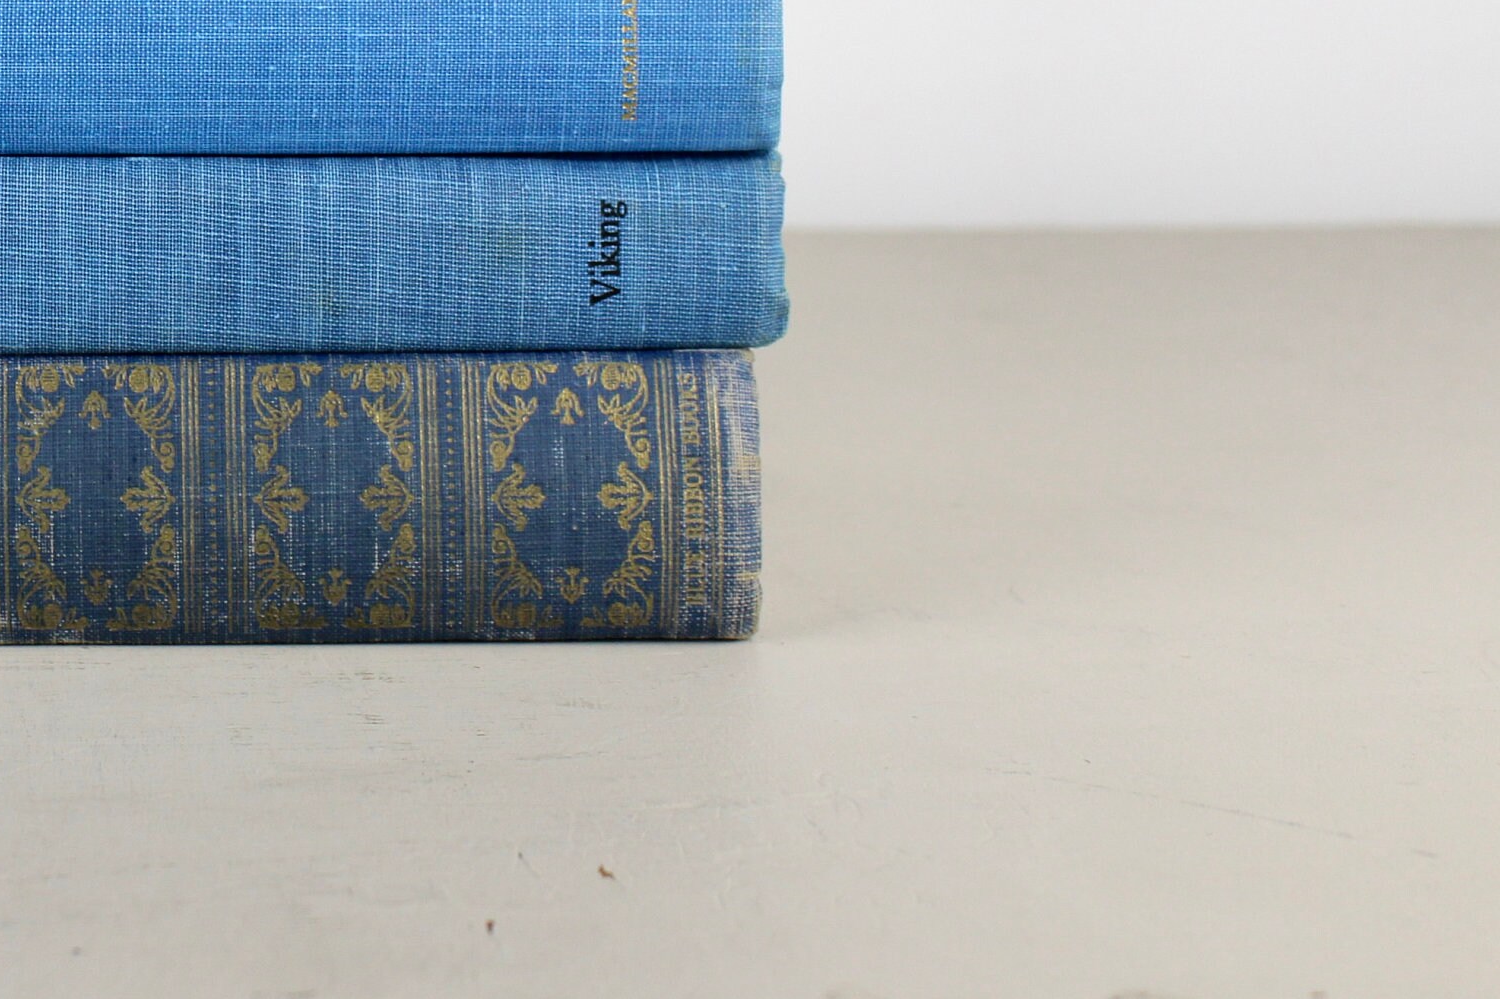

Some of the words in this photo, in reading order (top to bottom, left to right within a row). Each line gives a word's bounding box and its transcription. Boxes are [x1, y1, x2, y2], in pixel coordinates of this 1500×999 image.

[587, 200, 628, 306] Viking
[678, 372, 702, 445] BOOKS
[683, 455, 705, 540] RIBBON
